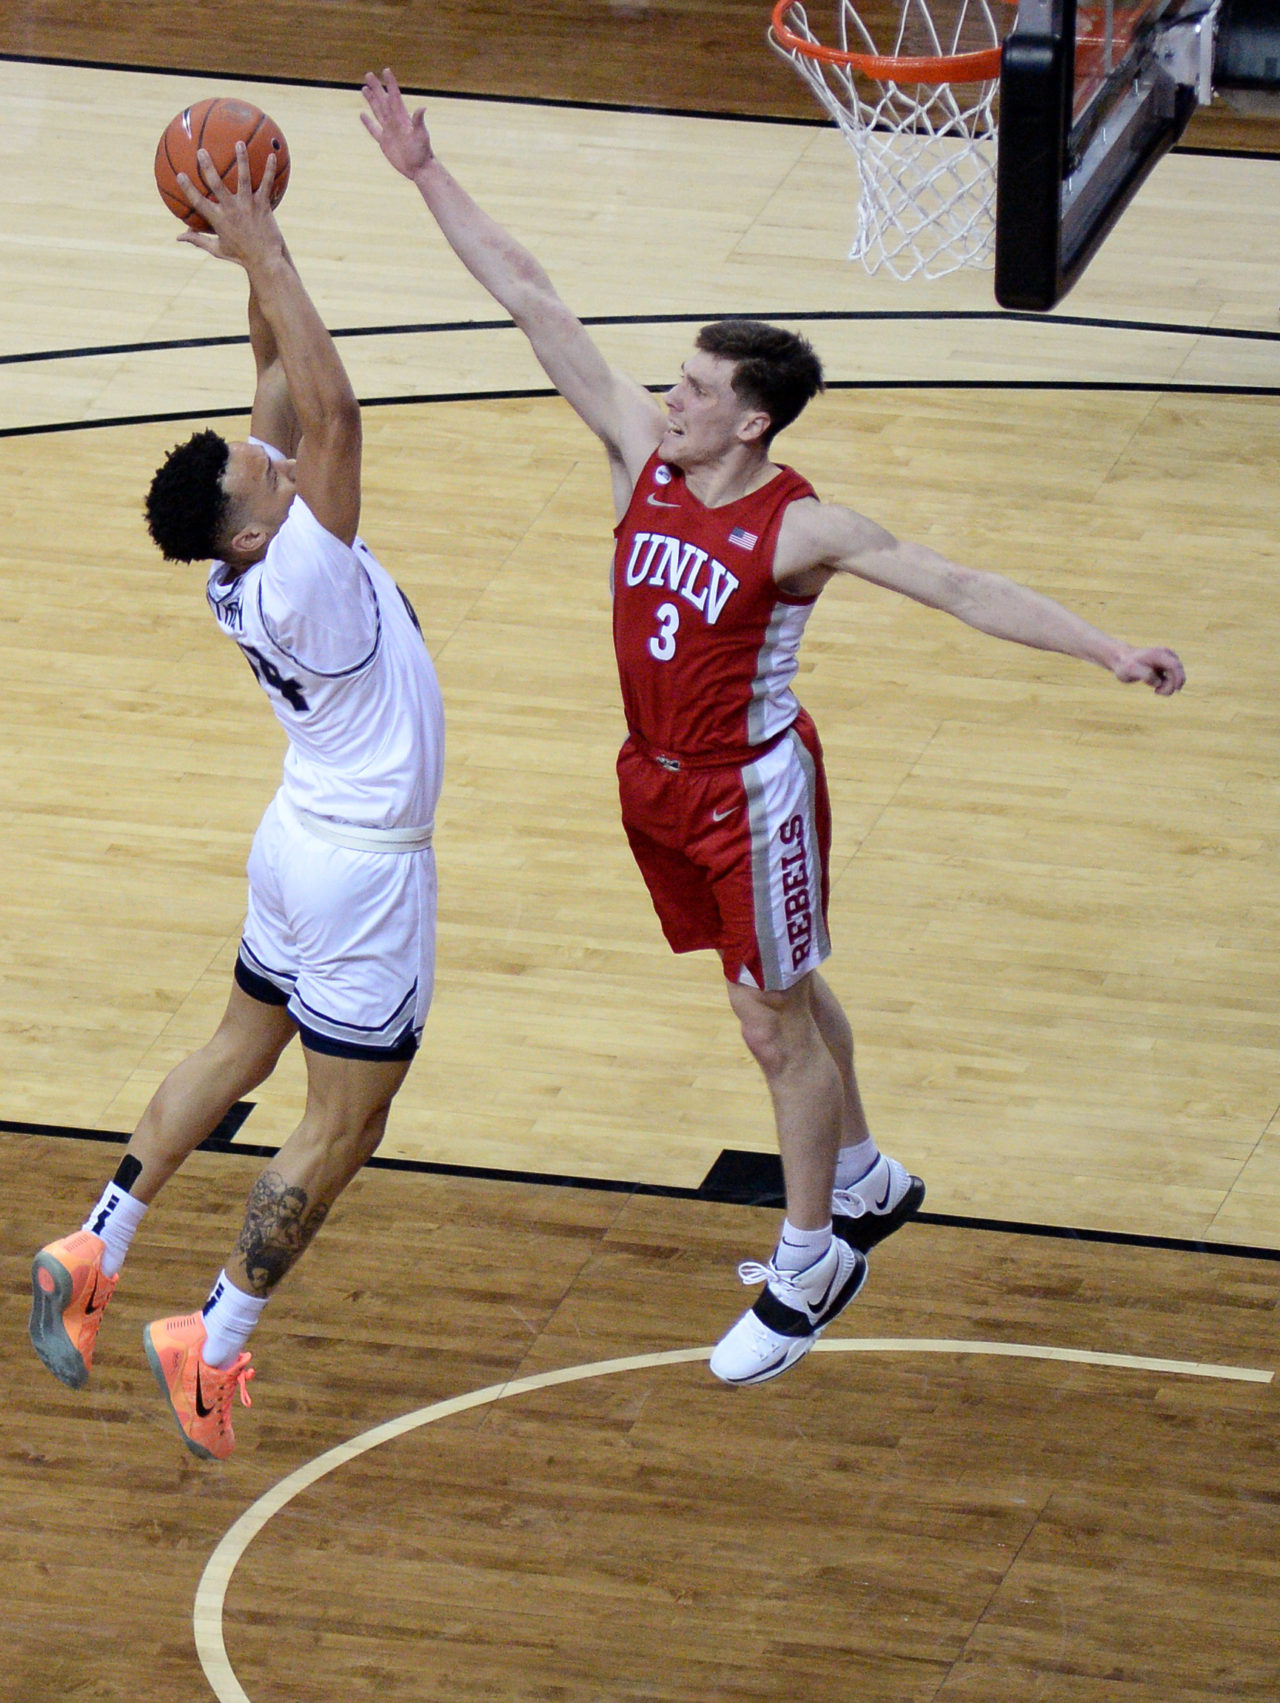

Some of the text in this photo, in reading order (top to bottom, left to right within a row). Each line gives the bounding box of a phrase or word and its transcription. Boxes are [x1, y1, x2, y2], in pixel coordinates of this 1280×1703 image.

[626, 532, 740, 625] UNLV
[650, 603, 679, 661] 3
[779, 814, 812, 971] REBELS
